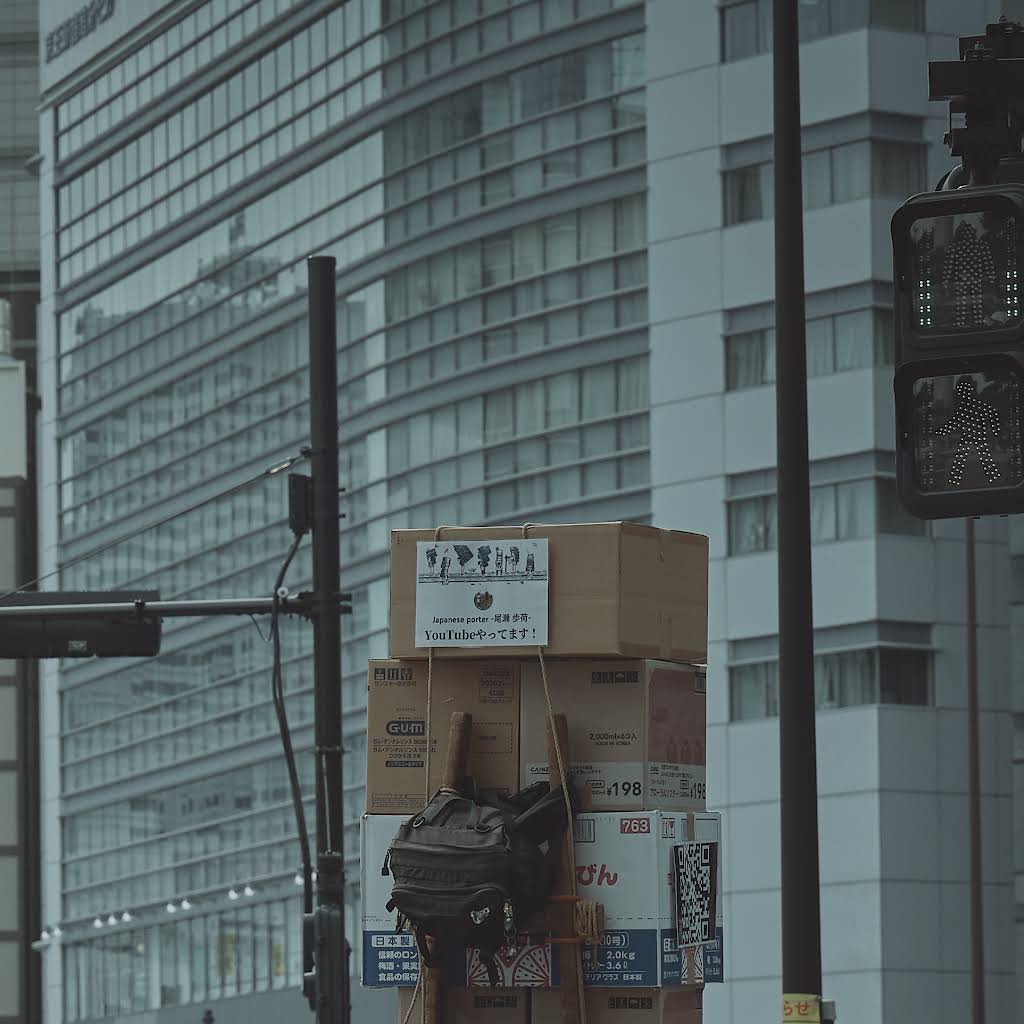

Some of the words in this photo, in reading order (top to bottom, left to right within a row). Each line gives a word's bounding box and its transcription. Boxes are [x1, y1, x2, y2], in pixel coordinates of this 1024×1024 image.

[432, 616, 465, 625] Japanese
[466, 616, 489, 625] porter
[607, 781, 642, 797] ¥198
[622, 820, 649, 832] 763
[376, 936, 410, 946] 日本製
[606, 951, 636, 961] 2.0kg
